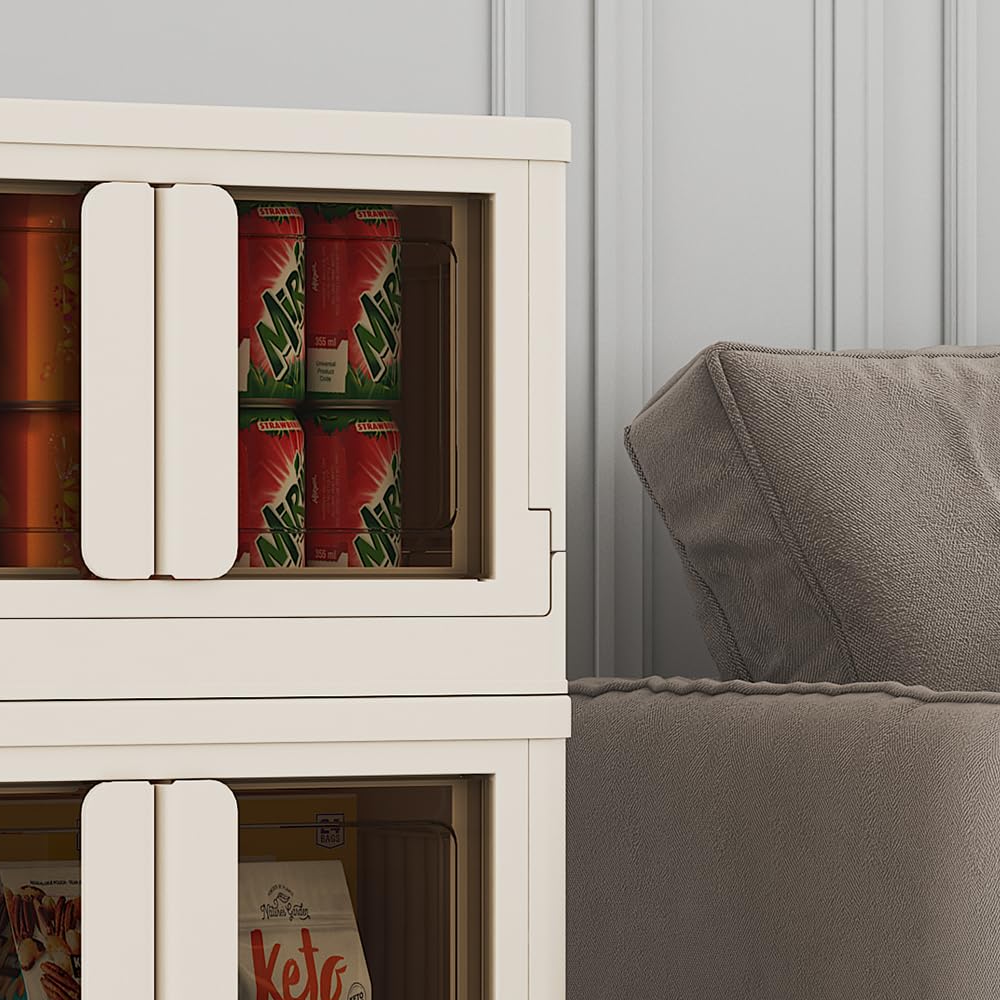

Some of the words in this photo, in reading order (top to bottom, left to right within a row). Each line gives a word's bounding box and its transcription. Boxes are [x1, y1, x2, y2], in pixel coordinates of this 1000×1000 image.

[314, 337, 327, 346] 355
[328, 337, 337, 346] ml
[315, 549, 327, 559] 355
[328, 549, 337, 559] ml
